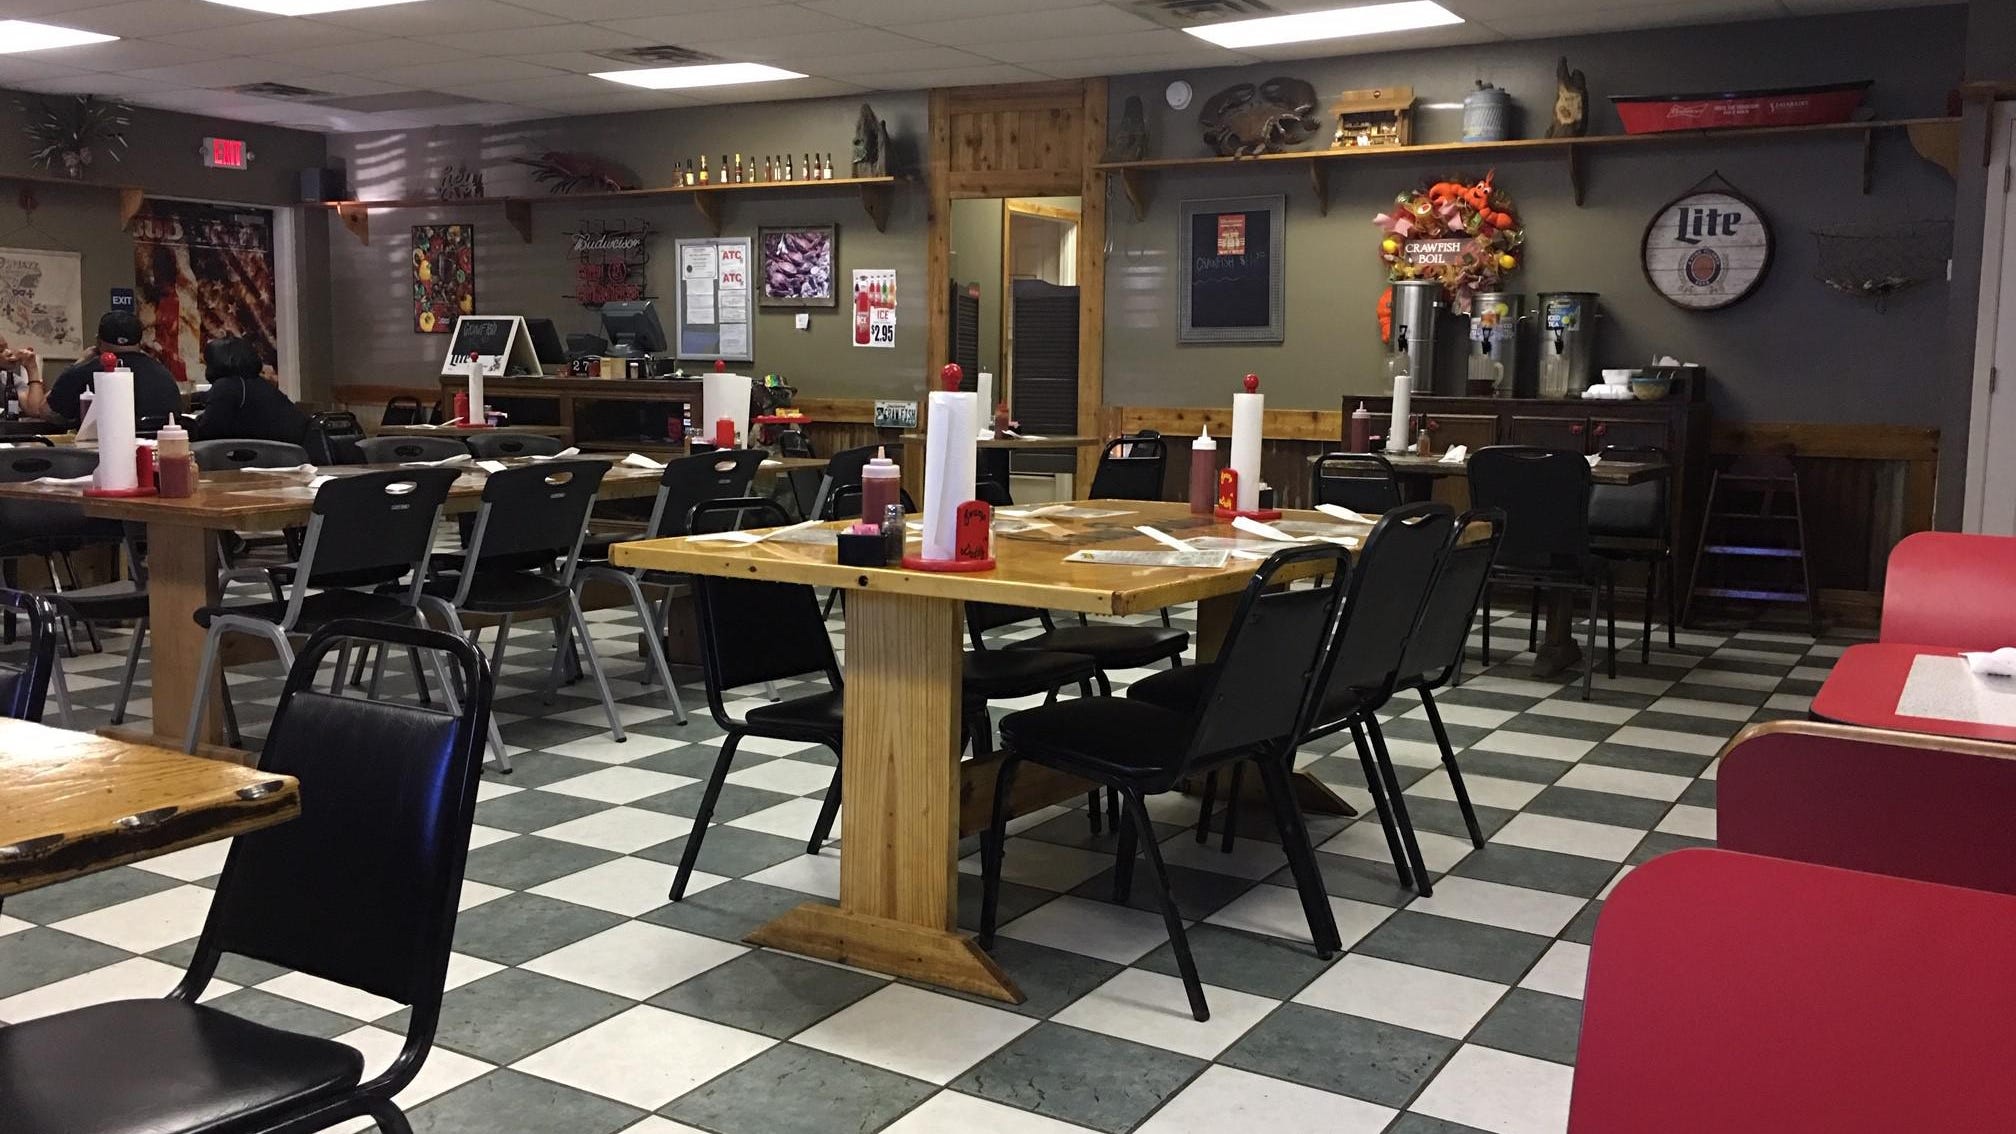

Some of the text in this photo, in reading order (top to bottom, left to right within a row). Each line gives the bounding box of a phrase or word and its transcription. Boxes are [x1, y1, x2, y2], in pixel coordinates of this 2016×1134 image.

[213, 139, 241, 166] EXIT
[1674, 207, 1741, 245] Lite
[574, 233, 641, 251] Budweiser
[1405, 242, 1461, 253] CRAWFISH
[722, 250, 742, 260] ATC
[1418, 253, 1445, 264] BOIL
[722, 273, 742, 283] ATC
[112, 295, 133, 305] EXIT
[877, 310, 889, 320] ICE
[871, 324, 893, 342] $2.95
